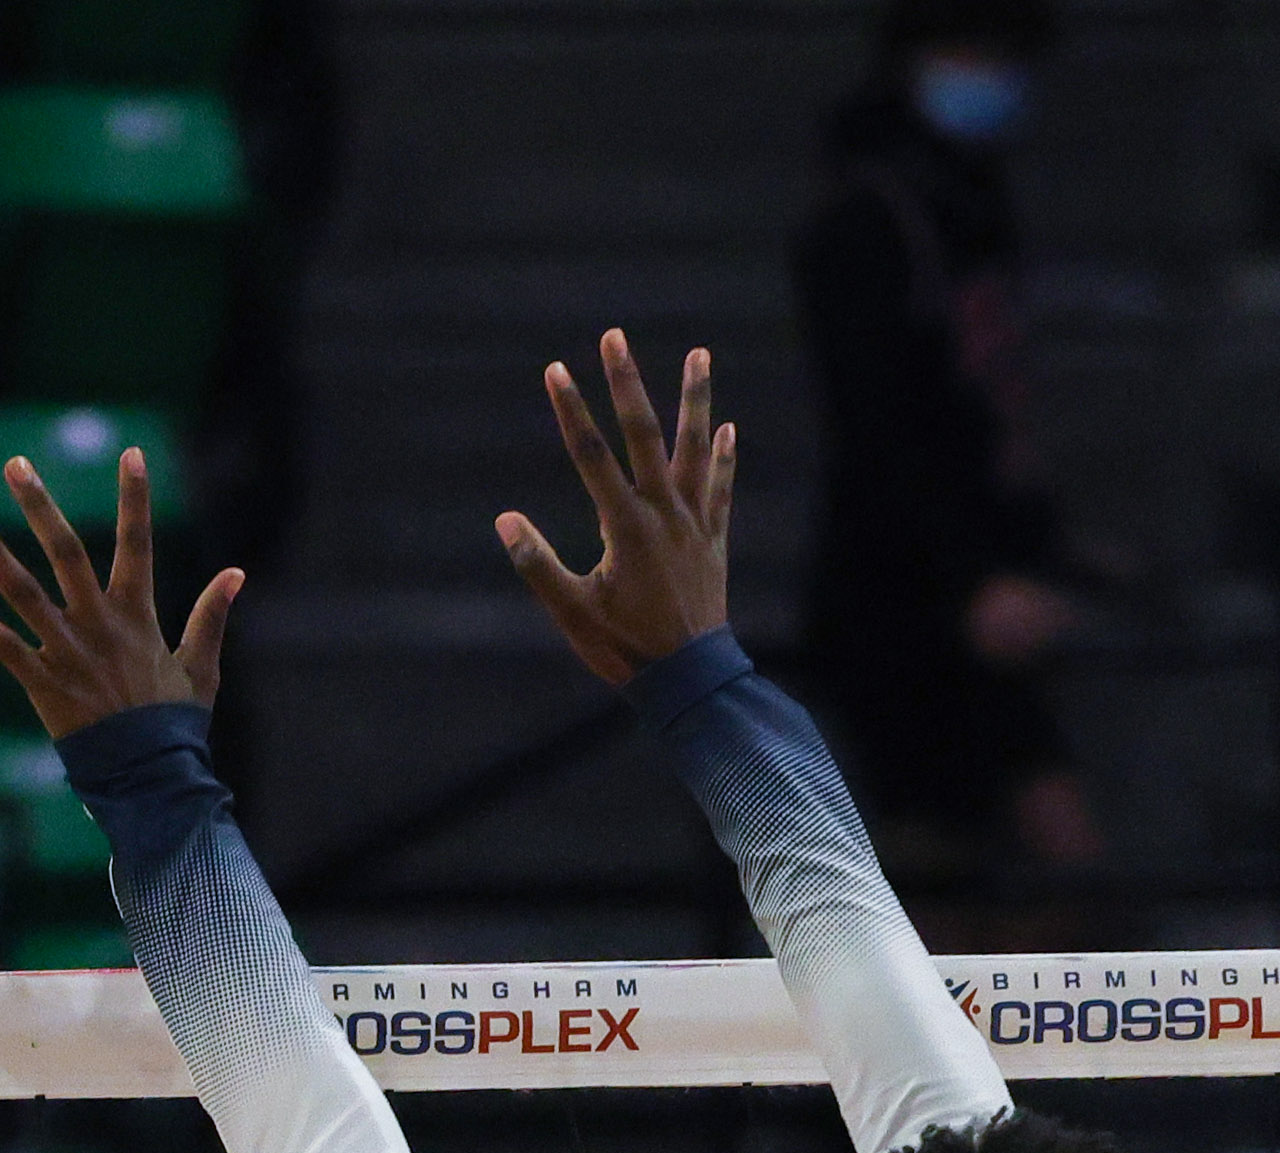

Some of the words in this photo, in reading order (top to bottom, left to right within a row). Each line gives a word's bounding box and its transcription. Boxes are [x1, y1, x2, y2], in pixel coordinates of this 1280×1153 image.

[332, 979, 638, 1001] RMINGHAM
[992, 967, 1280, 990] BIRMINGH
[334, 1008, 640, 1056] OSSPLEX
[990, 996, 1280, 1045] CROSSPL
